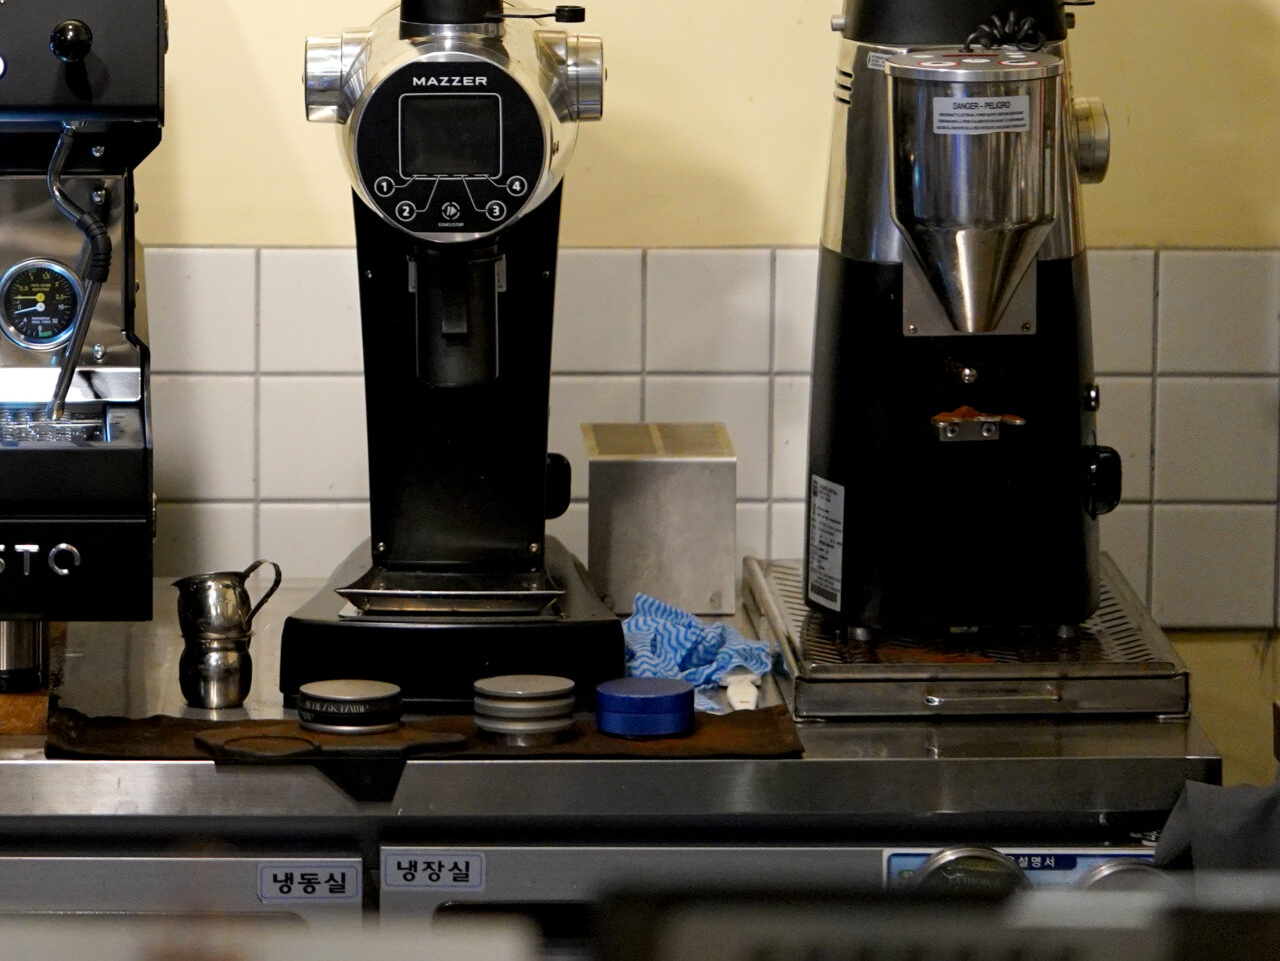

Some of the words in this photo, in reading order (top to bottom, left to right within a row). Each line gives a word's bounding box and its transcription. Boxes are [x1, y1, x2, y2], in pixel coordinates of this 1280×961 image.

[411, 75, 488, 87] MAZZER
[952, 102, 979, 110] DANGER
[984, 101, 1011, 110] PELIGRO
[395, 859, 472, 884] 냉장실
[271, 870, 348, 895] 냉동실
